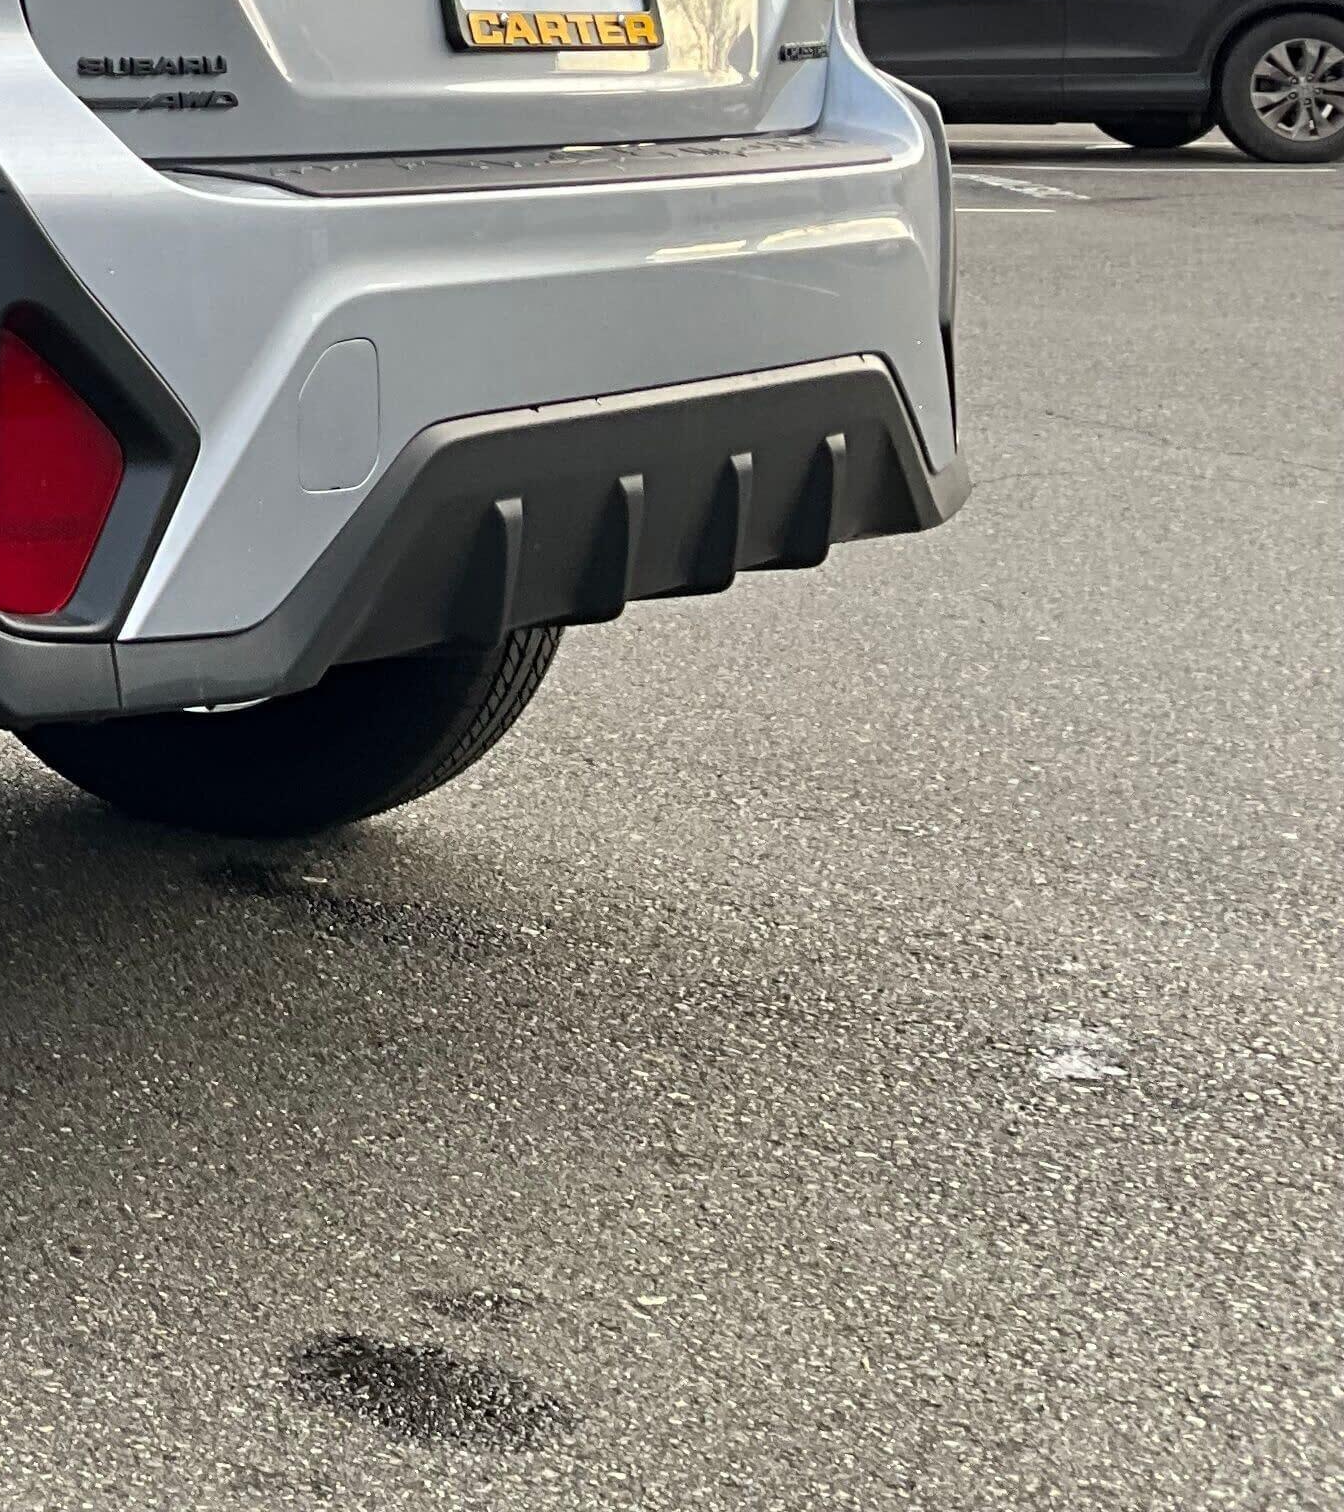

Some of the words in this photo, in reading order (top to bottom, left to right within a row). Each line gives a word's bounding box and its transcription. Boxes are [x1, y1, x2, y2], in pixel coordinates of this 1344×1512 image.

[469, 12, 658, 45] CARTER
[77, 54, 228, 76] SUBARU
[142, 90, 239, 110] AWD
